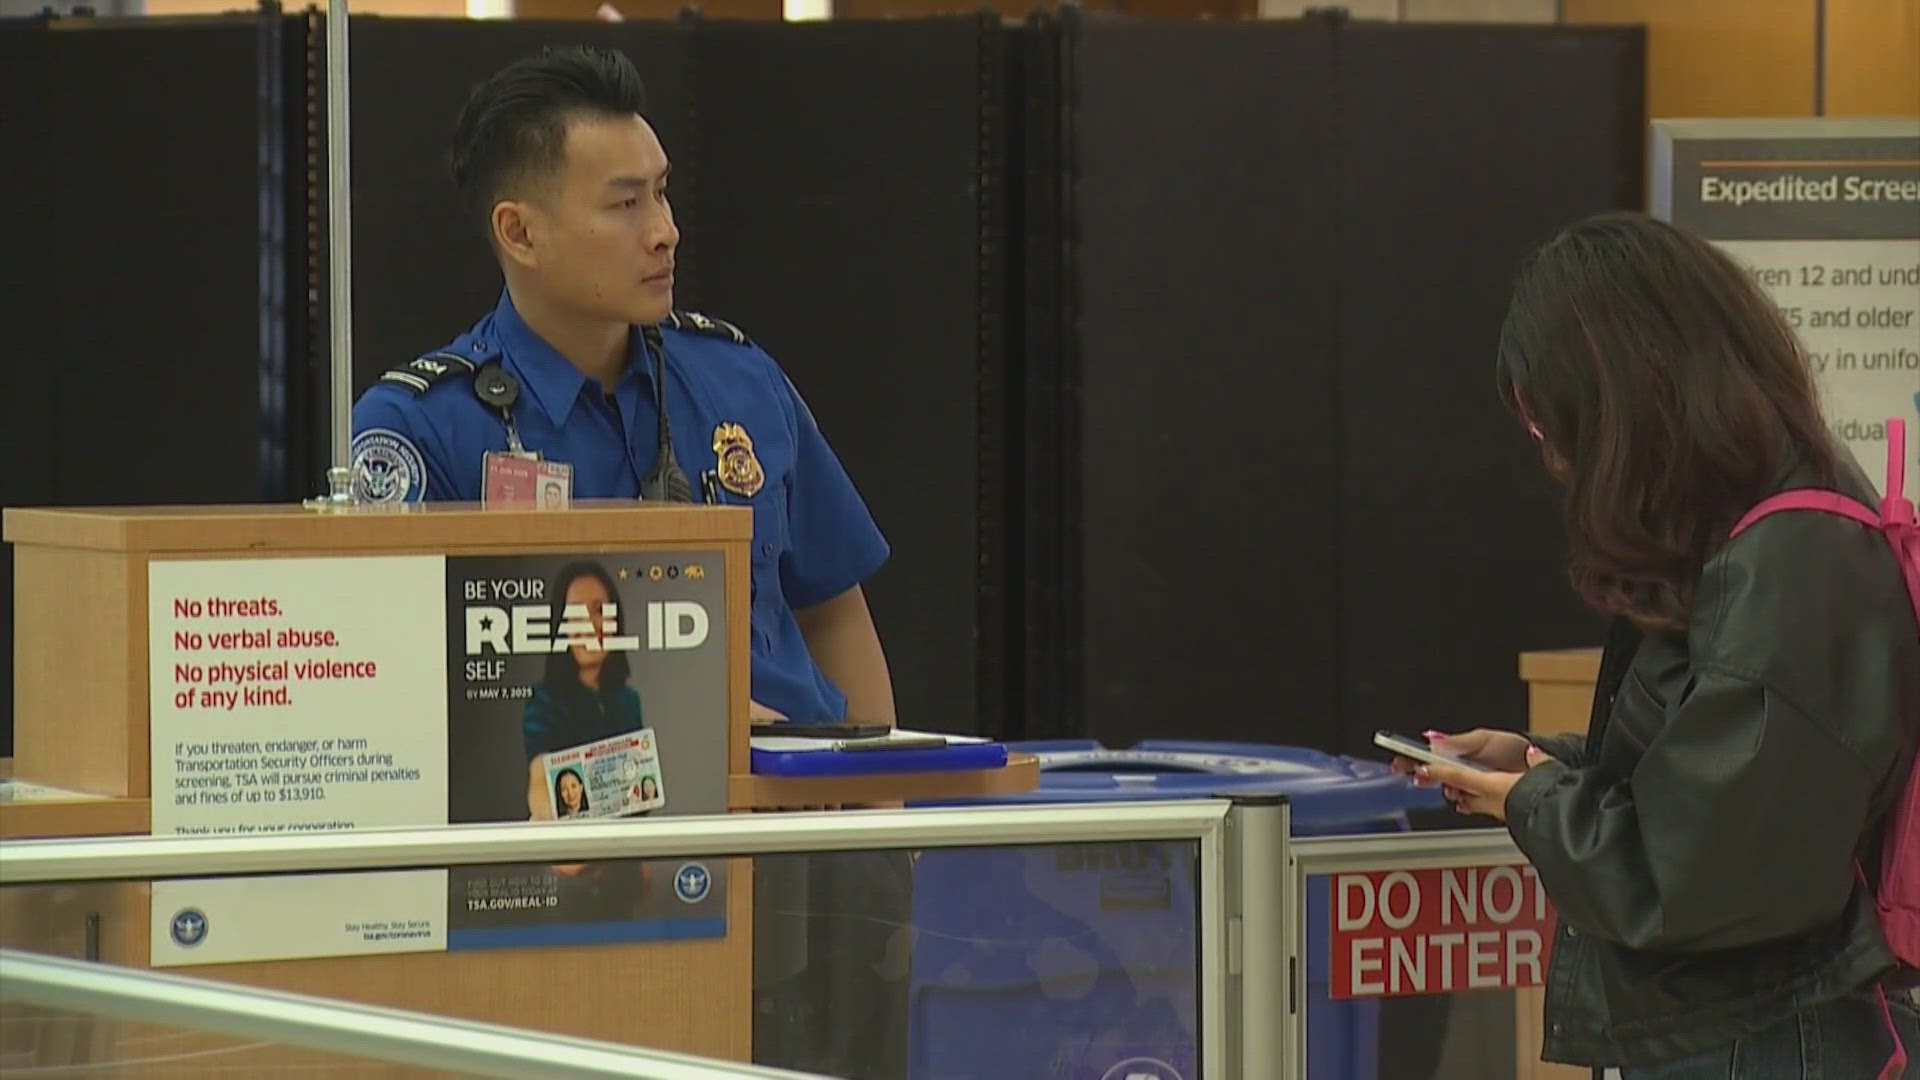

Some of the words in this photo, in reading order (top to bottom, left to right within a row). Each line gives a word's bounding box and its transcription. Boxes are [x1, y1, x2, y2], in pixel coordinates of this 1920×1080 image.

[1701, 175, 1838, 206] Expedited
[1843, 176, 1920, 201] Scree
[1801, 266, 1825, 286] 12
[1832, 265, 1872, 286] and
[1810, 306, 1850, 327] and
[1857, 306, 1914, 327] older
[1837, 349, 1856, 369] in
[464, 580, 487, 599] BE
[491, 578, 544, 599] YOUR
[174, 598, 202, 618] No
[207, 597, 283, 617] threats.
[174, 631, 203, 650] No
[208, 628, 271, 649] verbal
[276, 627, 339, 648] abuse.
[465, 602, 639, 655] REAL
[647, 601, 710, 650] ID
[175, 663, 203, 683] No
[208, 660, 288, 685] physical
[294, 659, 377, 680] violence
[465, 660, 505, 681] SELF
[174, 688, 196, 709] of
[200, 690, 238, 711] any
[244, 685, 292, 706] kind.
[466, 690, 478, 700] BY
[480, 688, 500, 699] MAY
[175, 743, 184, 755] If
[186, 745, 209, 758] you
[212, 741, 262, 755] threaten,
[265, 739, 319, 754] endanger,
[322, 741, 335, 751] or
[337, 738, 367, 750] harm
[175, 757, 258, 774] Transportation
[261, 755, 306, 770] Security
[310, 753, 354, 767] Officers
[357, 751, 393, 767] during
[175, 774, 232, 790] screening,
[235, 773, 258, 786] TSA
[261, 770, 280, 784] will
[282, 773, 321, 787] pursue
[324, 768, 368, 783] criminal
[371, 767, 420, 783] penalties
[175, 792, 197, 805] and
[200, 790, 228, 804] fines
[231, 789, 244, 802] of
[246, 790, 261, 804] up
[264, 789, 276, 801] to
[468, 896, 558, 911] TSA.GOV/REAL-ID
[1337, 871, 1421, 932] DO
[1441, 866, 1546, 926] NOT
[1351, 929, 1544, 995] ENTER
